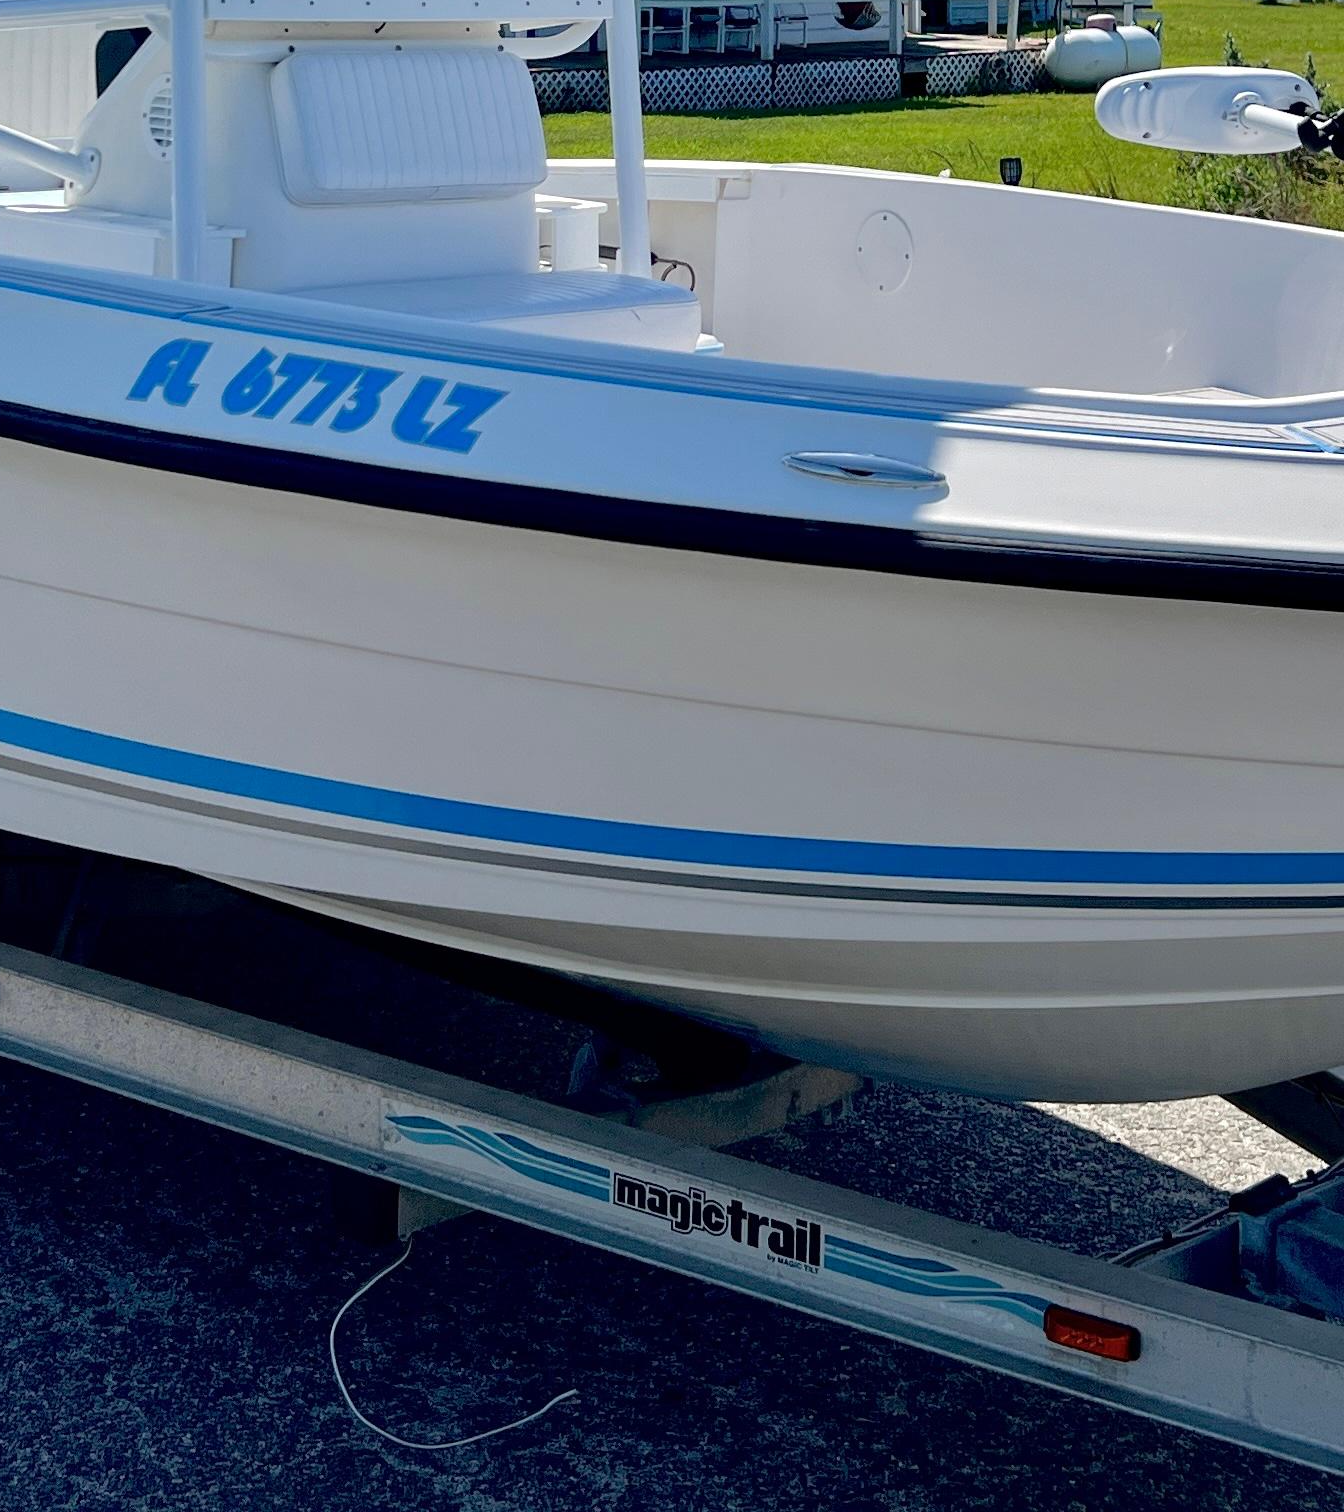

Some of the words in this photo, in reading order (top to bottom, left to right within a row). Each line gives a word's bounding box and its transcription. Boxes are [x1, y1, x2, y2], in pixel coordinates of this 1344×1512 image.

[126, 338, 213, 407] FL
[221, 347, 404, 434] 6773
[391, 376, 510, 455] LZ
[767, 1253, 776, 1263] by
[777, 1256, 802, 1270] MAGIC
